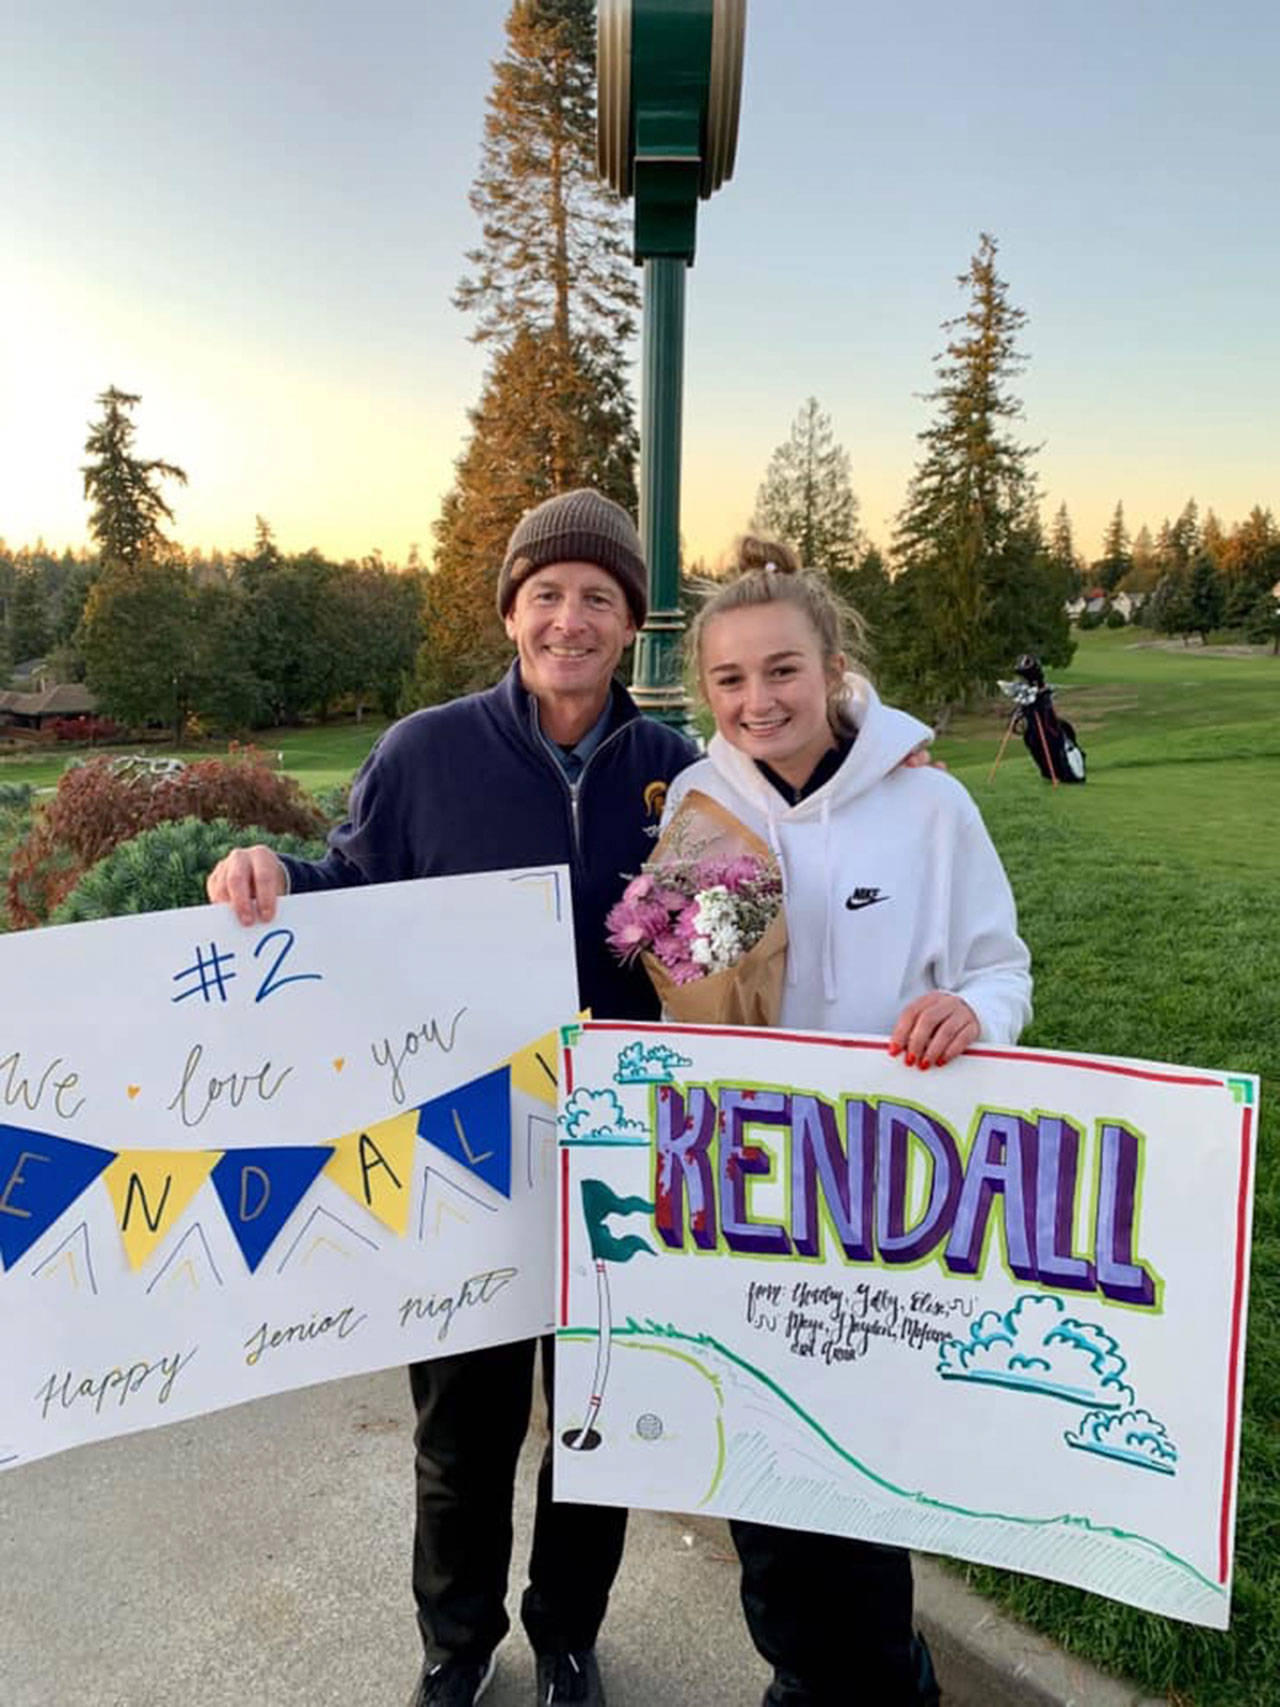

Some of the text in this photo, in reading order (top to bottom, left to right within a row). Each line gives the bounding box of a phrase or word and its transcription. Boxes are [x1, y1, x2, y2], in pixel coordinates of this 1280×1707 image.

[172, 929, 322, 1003] #2
[0, 1007, 468, 1127] We love you
[650, 1079, 1164, 1314] KENDALL
[35, 1347, 197, 1419] Happy
[400, 1267, 518, 1342] night
